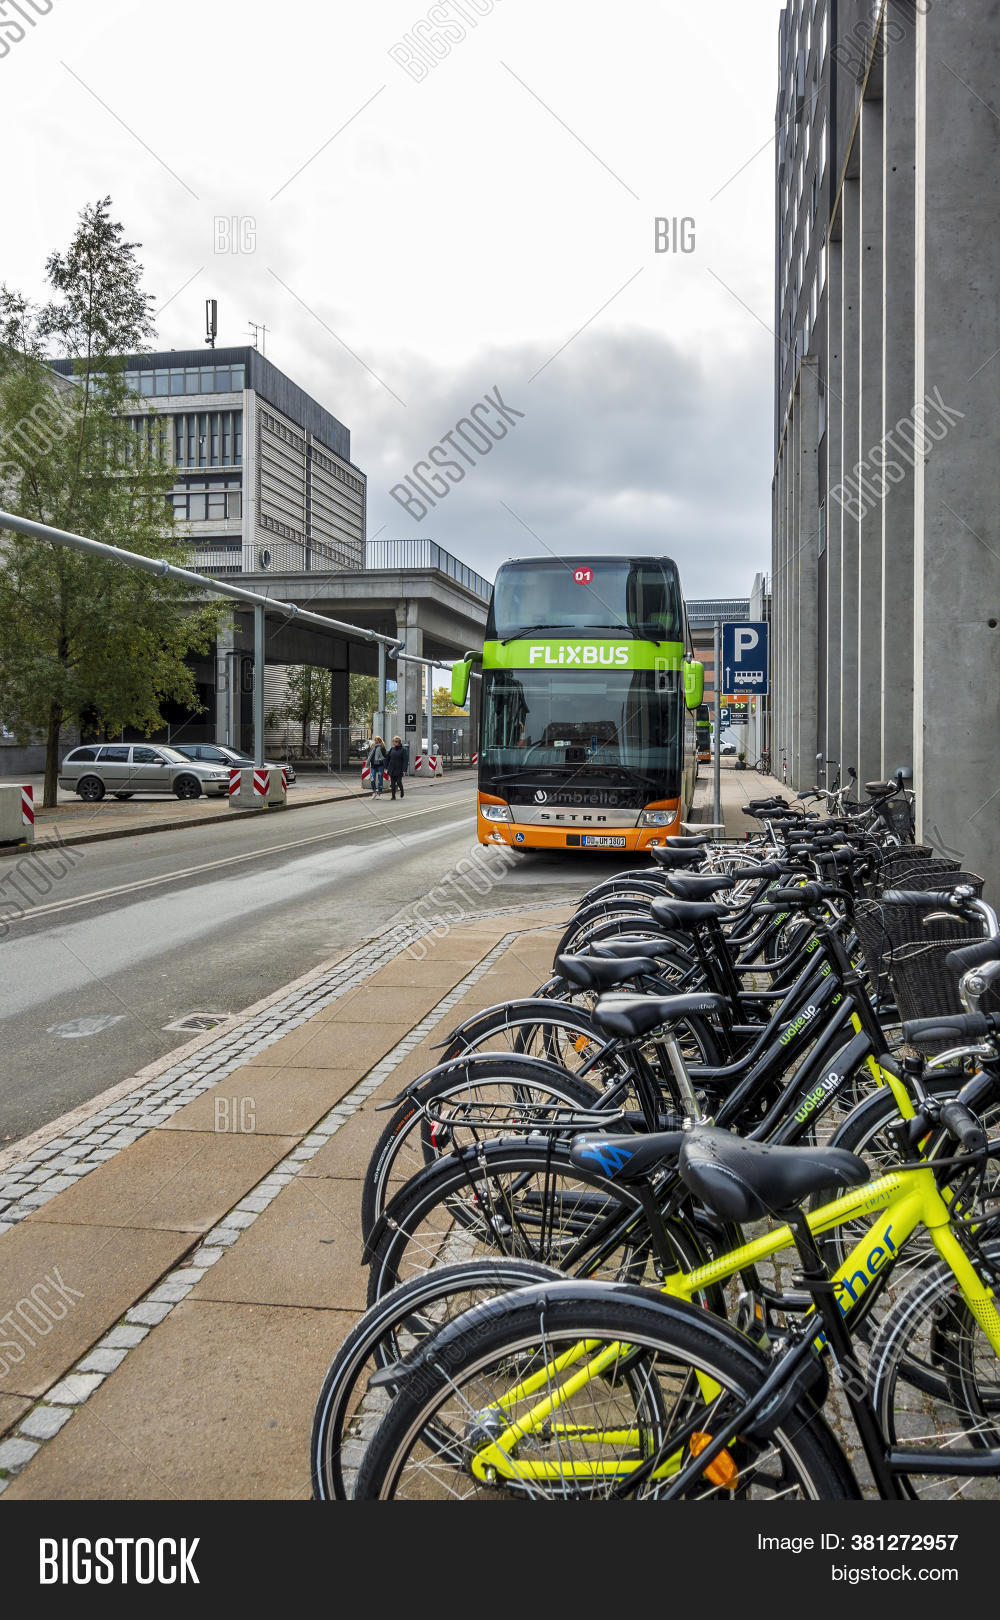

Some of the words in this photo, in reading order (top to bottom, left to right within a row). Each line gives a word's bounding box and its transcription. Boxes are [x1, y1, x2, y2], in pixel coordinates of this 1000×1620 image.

[575, 571, 591, 581] 01
[734, 628, 759, 662] P
[407, 714, 414, 724] P
[720, 709, 728, 720] P
[540, 813, 607, 822] SETRA
